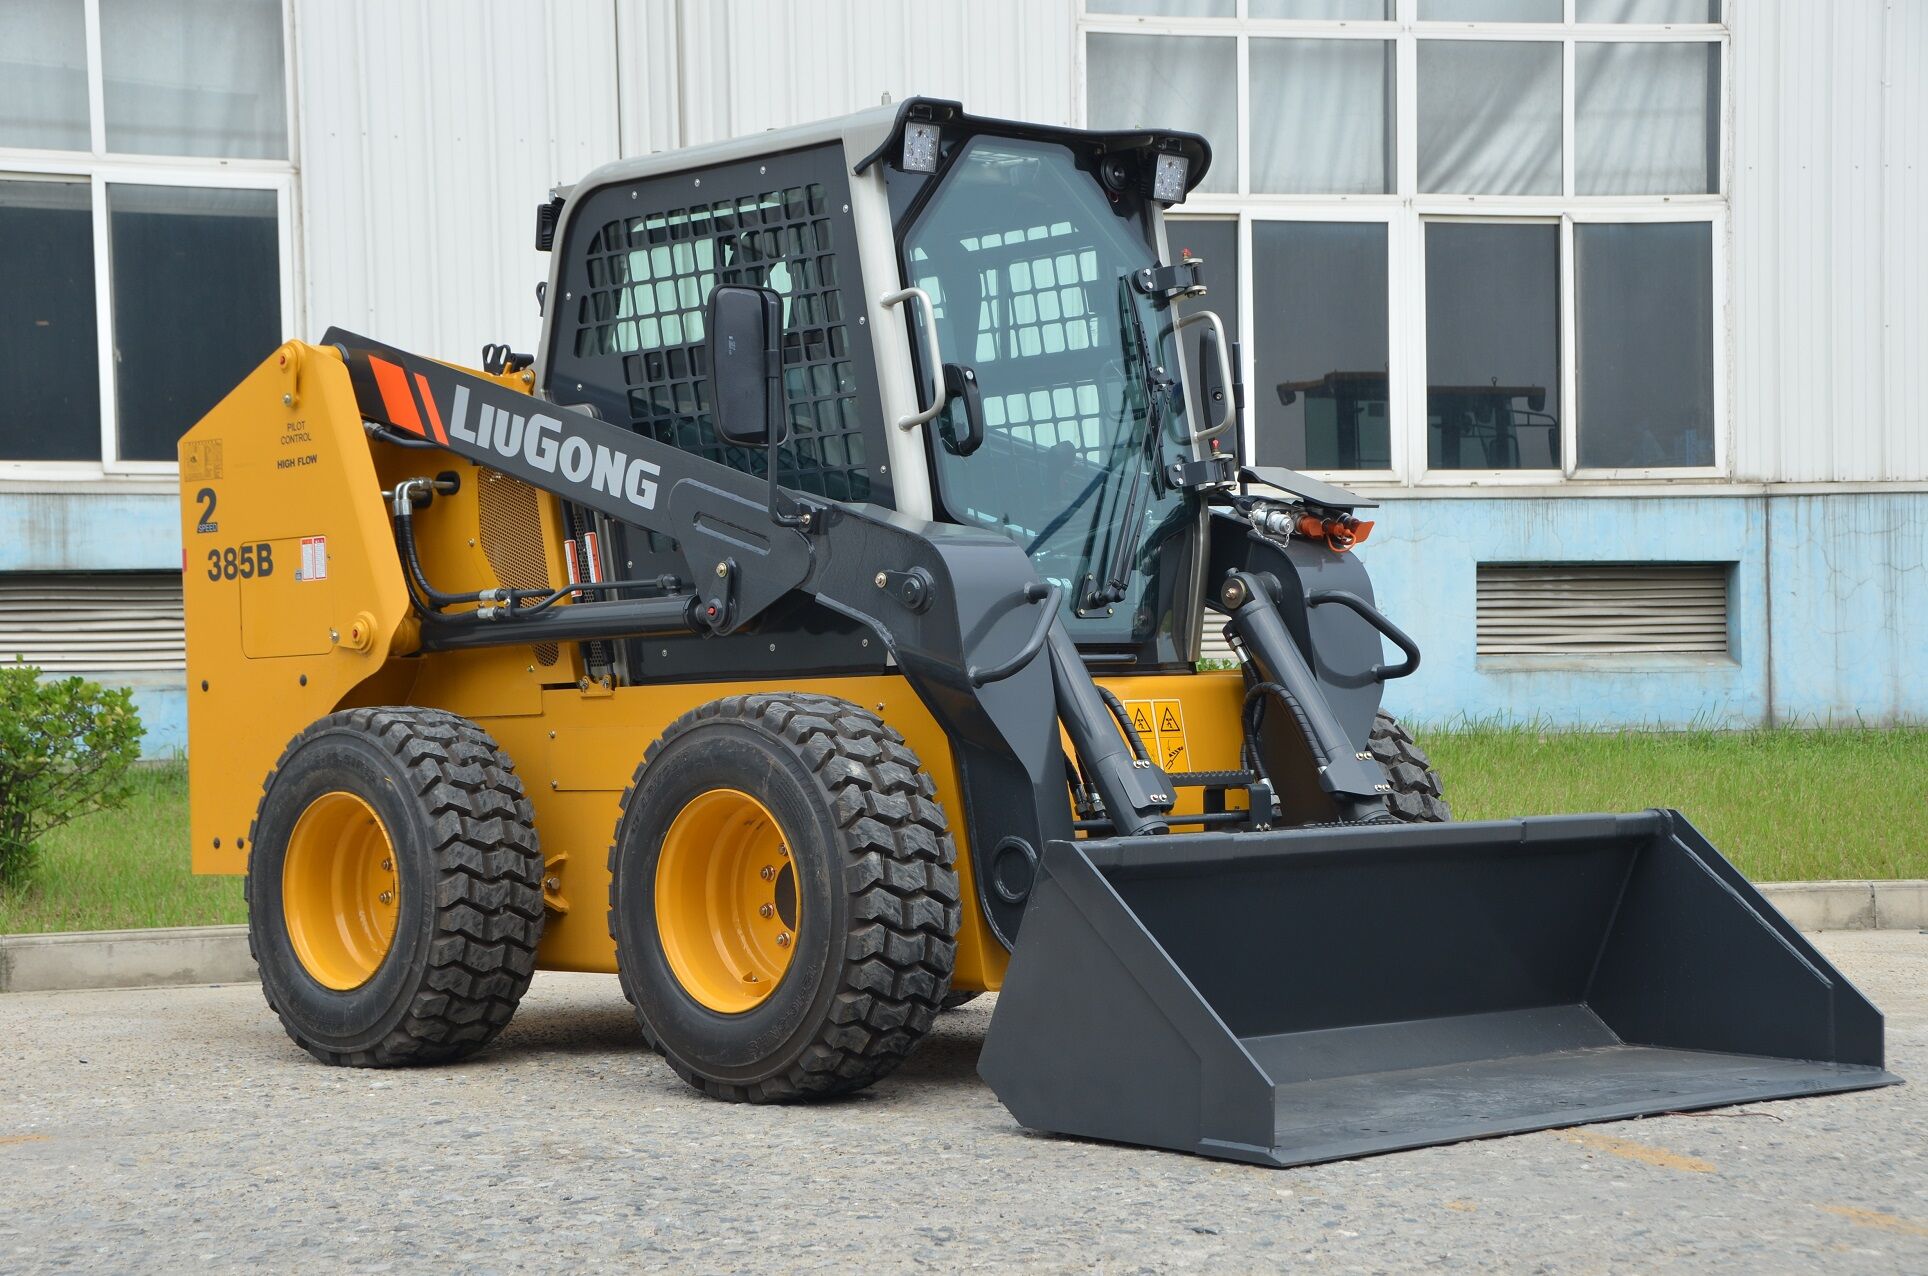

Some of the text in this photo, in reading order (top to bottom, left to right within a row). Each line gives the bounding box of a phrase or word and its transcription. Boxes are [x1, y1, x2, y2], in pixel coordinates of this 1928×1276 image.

[287, 421, 305, 431] PILOT
[280, 432, 312, 445] CONTROL
[277, 454, 318, 470] HIGH FLOW
[196, 487, 217, 533] 2
[198, 523, 217, 533] SPEED
[207, 543, 273, 582] 385B
